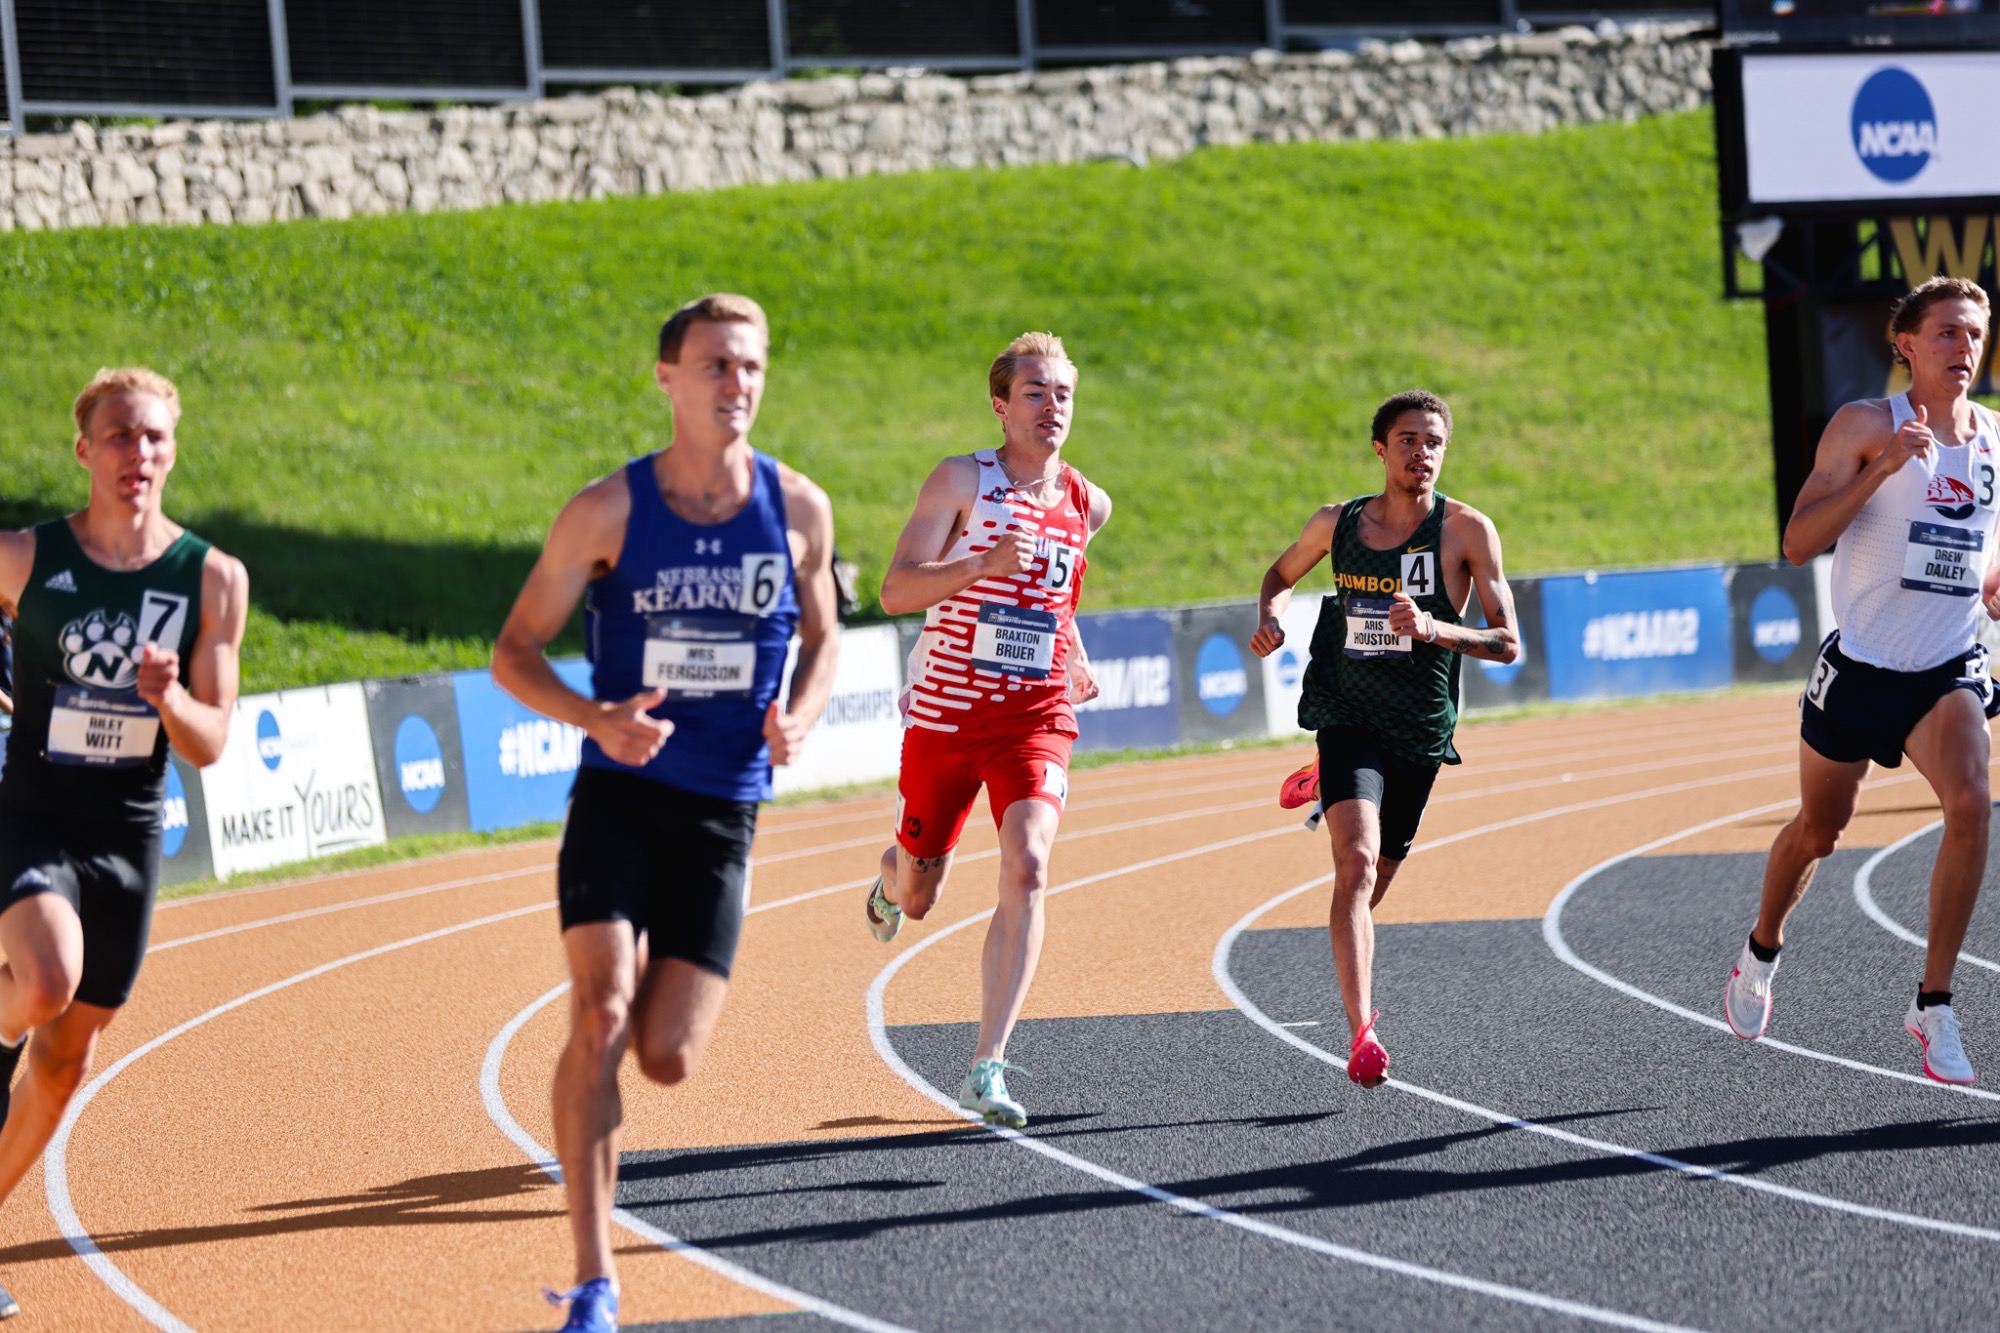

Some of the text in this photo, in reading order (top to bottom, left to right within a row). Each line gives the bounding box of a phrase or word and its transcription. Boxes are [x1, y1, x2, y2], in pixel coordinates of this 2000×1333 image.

[1859, 120, 1937, 158] NCAA
[1979, 464, 1995, 506] 3
[1051, 547, 1070, 588] 5
[1934, 548, 1964, 563] DREW
[656, 566, 742, 588] NEBRASK
[1333, 572, 1402, 593] HUMBOL
[1407, 555, 1429, 593] 4
[1925, 562, 1967, 580] DAILEY
[752, 559, 775, 609] 6
[632, 584, 740, 613] KEARN
[149, 596, 179, 643] 7
[1364, 620, 1384, 631] ARIS
[995, 628, 1040, 645] BRAXTON
[1354, 632, 1399, 645] HOUSTON
[1753, 618, 1800, 647] NCAA
[687, 647, 715, 660] WES
[996, 643, 1035, 661] BRUER
[82, 652, 125, 683] N
[657, 664, 740, 681] FERGUSON
[1810, 662, 1829, 701] 3
[89, 716, 124, 730] RILEY
[85, 733, 123, 750] WITT
[401, 757, 445, 792] NCAA
[222, 769, 374, 858] MAKE IT YOURS
